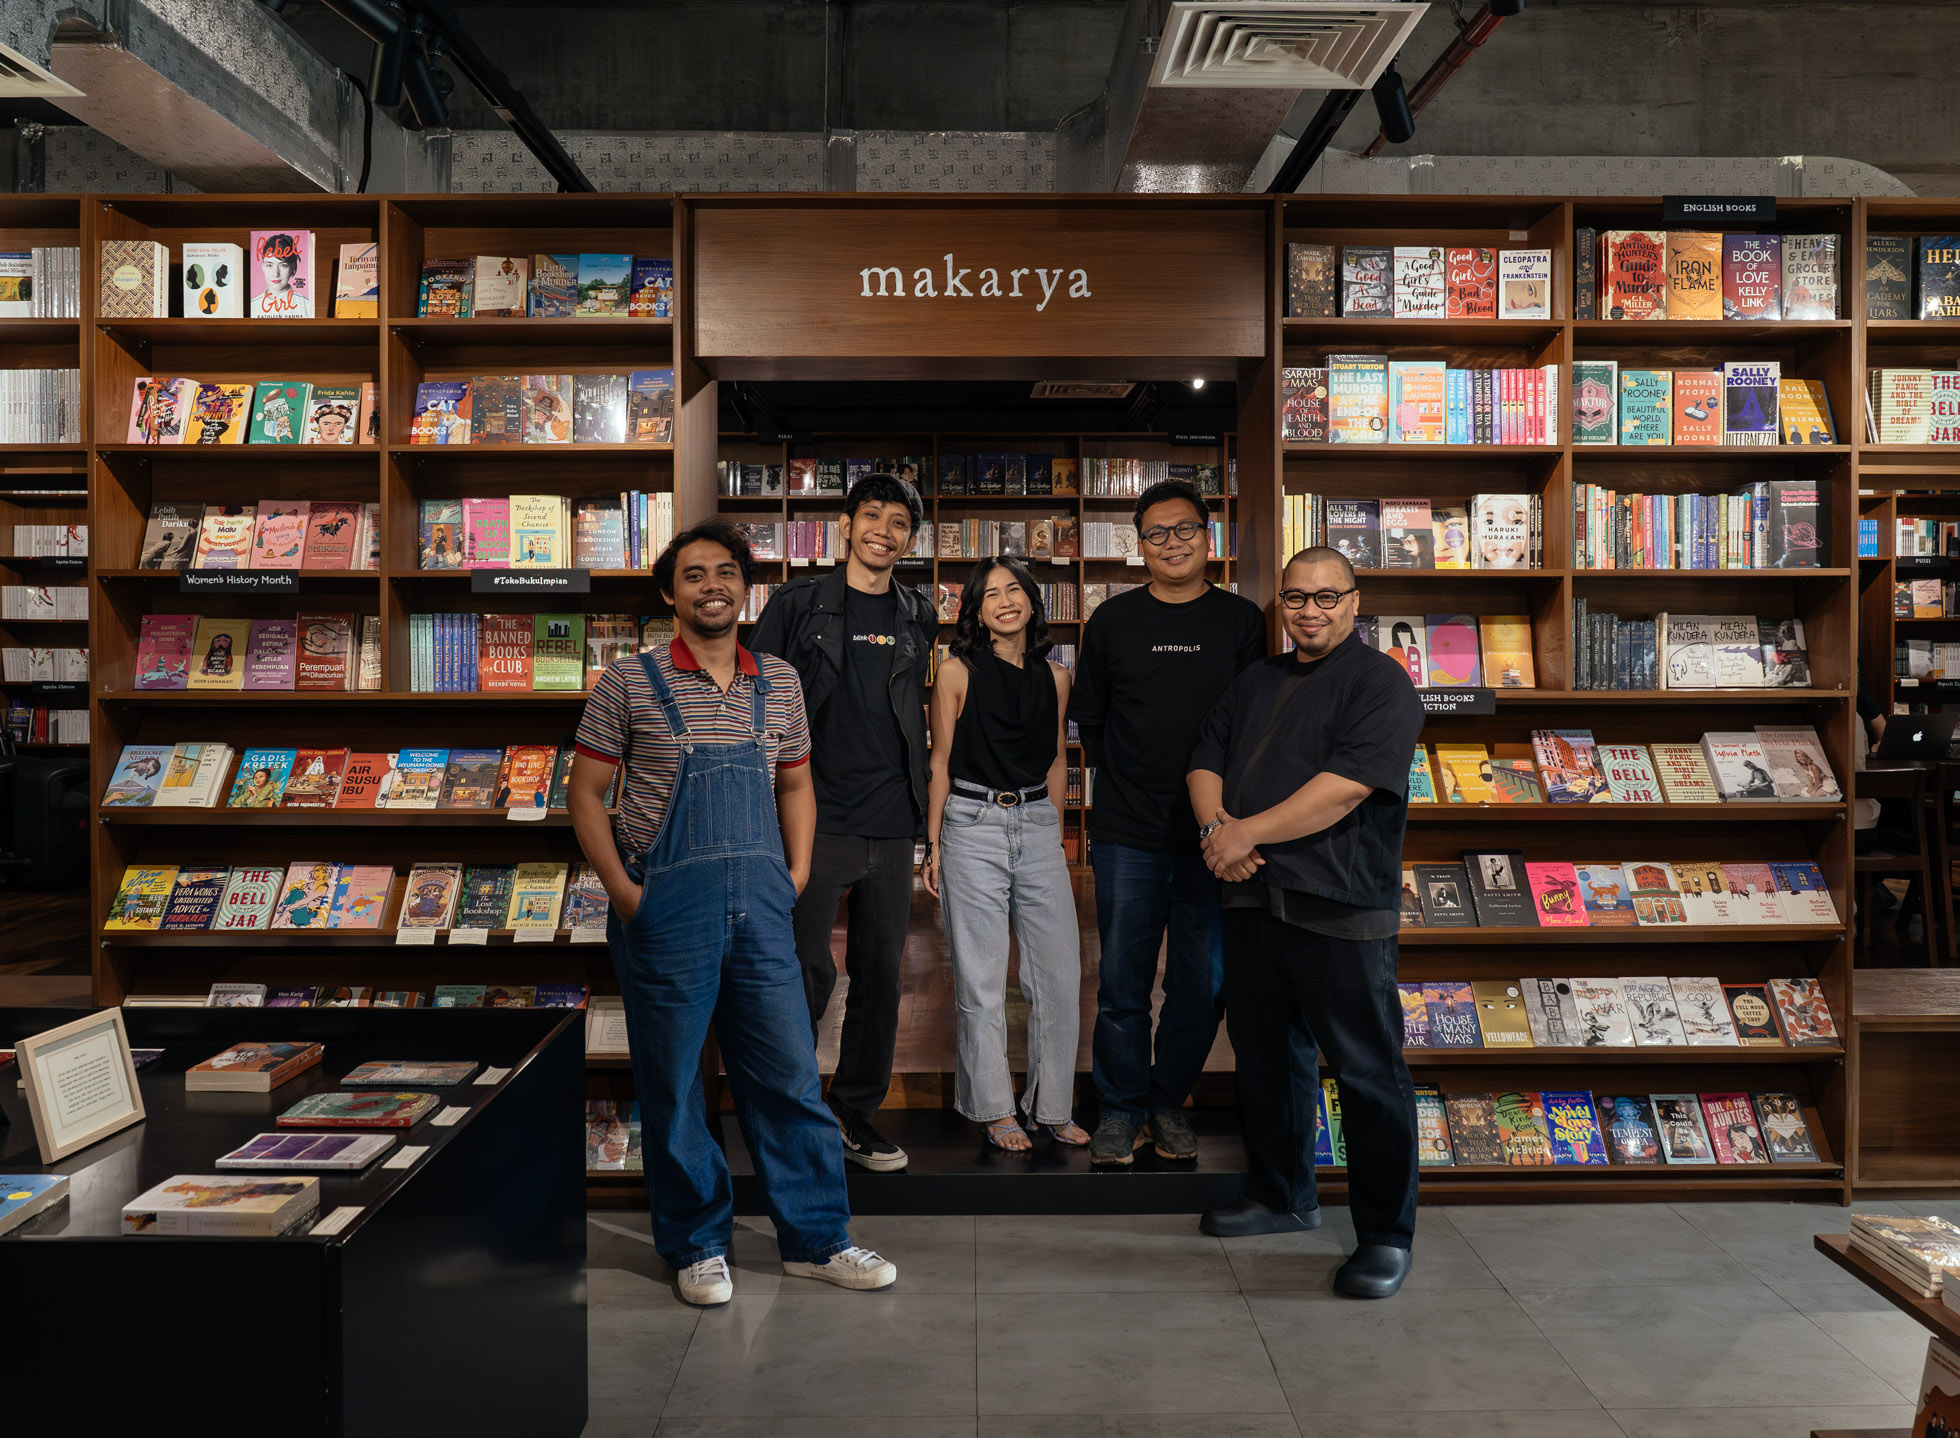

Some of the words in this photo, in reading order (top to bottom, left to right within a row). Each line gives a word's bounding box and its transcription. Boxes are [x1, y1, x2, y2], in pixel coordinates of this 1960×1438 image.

[256, 235, 302, 262] Rebel
[1618, 242, 1657, 251] ANTIQUE
[1744, 241, 1761, 249] THE
[1449, 251, 1472, 264] Good
[1503, 256, 1547, 264] CLEOPATRA
[1732, 250, 1773, 262] BOOK
[1411, 259, 1435, 271] Good
[1747, 262, 1759, 271] OF
[1355, 270, 1382, 283] Good
[1736, 272, 1769, 284] LOVE
[542, 278, 577, 286] MURDER
[860, 253, 1092, 311] makarya
[1673, 278, 1715, 291] FLAME
[1459, 287, 1480, 299] Bad
[1738, 286, 1767, 297] KELLY
[262, 289, 298, 313] Girl
[1352, 299, 1378, 310] Dead
[1403, 299, 1439, 312] Murder
[1742, 298, 1764, 308] LINK
[1466, 301, 1493, 314] Blood
[1284, 369, 1313, 379] SARAH
[1732, 367, 1770, 377] SALLY
[1333, 373, 1362, 383] THE
[1362, 373, 1385, 383] LAST
[1635, 378, 1659, 388] SALLY
[1727, 377, 1777, 386] ROONEY
[1892, 375, 1922, 383] JOHNNY
[1290, 379, 1319, 388] MAAS
[1334, 384, 1383, 394] MURDER
[1627, 389, 1667, 398] ROONEY
[427, 400, 456, 411] CAT
[1287, 399, 1321, 408] HOUSE
[1288, 413, 1320, 422] EARTH
[1633, 423, 1659, 432] WHERE
[1286, 428, 1322, 438] BLOOD
[1629, 432, 1643, 440] ARE
[161, 520, 189, 528] Dariku
[476, 520, 509, 528] DEATH
[1386, 519, 1408, 527] EGGS
[484, 530, 499, 538] OF
[501, 530, 509, 538] A
[478, 540, 509, 548] BOOK
[186, 574, 224, 584] Women's
[226, 575, 258, 586] History
[261, 575, 292, 584] Month
[494, 577, 568, 585] #TokoBukuImpian
[501, 620, 517, 629] THE
[1673, 621, 1700, 631] MILAN
[1720, 621, 1747, 631] MILAN
[486, 632, 531, 644] BANNED
[1668, 630, 1708, 641] KUNDERA
[1714, 630, 1756, 641] KUNDERA
[489, 646, 527, 659] BOOKS
[537, 640, 581, 655] REBEL
[300, 662, 344, 674] Perempuan
[494, 660, 523, 673] CLUB
[535, 675, 561, 683] ANDREW
[1609, 749, 1640, 760] THE
[348, 766, 371, 775] AIR
[1612, 769, 1651, 781] BELL
[346, 776, 382, 785] SUSU
[342, 786, 365, 795] IBU
[1622, 789, 1653, 802] JAR
[242, 871, 272, 883] THE
[1635, 868, 1664, 876] BACK
[229, 892, 266, 905] BELL
[1541, 890, 1573, 910] Bunny
[475, 900, 493, 908] Lost
[171, 905, 202, 914] ADVICE
[463, 908, 502, 916] Bookshop
[225, 914, 258, 927] JAR
[1434, 1013, 1474, 1024] HOUSE
[1443, 1024, 1476, 1034] MANY
[1440, 1033, 1473, 1045] WAYS
[1485, 1031, 1529, 1042] YELLOWFACE
[1708, 1103, 1724, 1113] DIAL
[1725, 1100, 1732, 1110] A
[1712, 1109, 1751, 1128] AUNTIES
[1509, 1135, 1544, 1144] James
